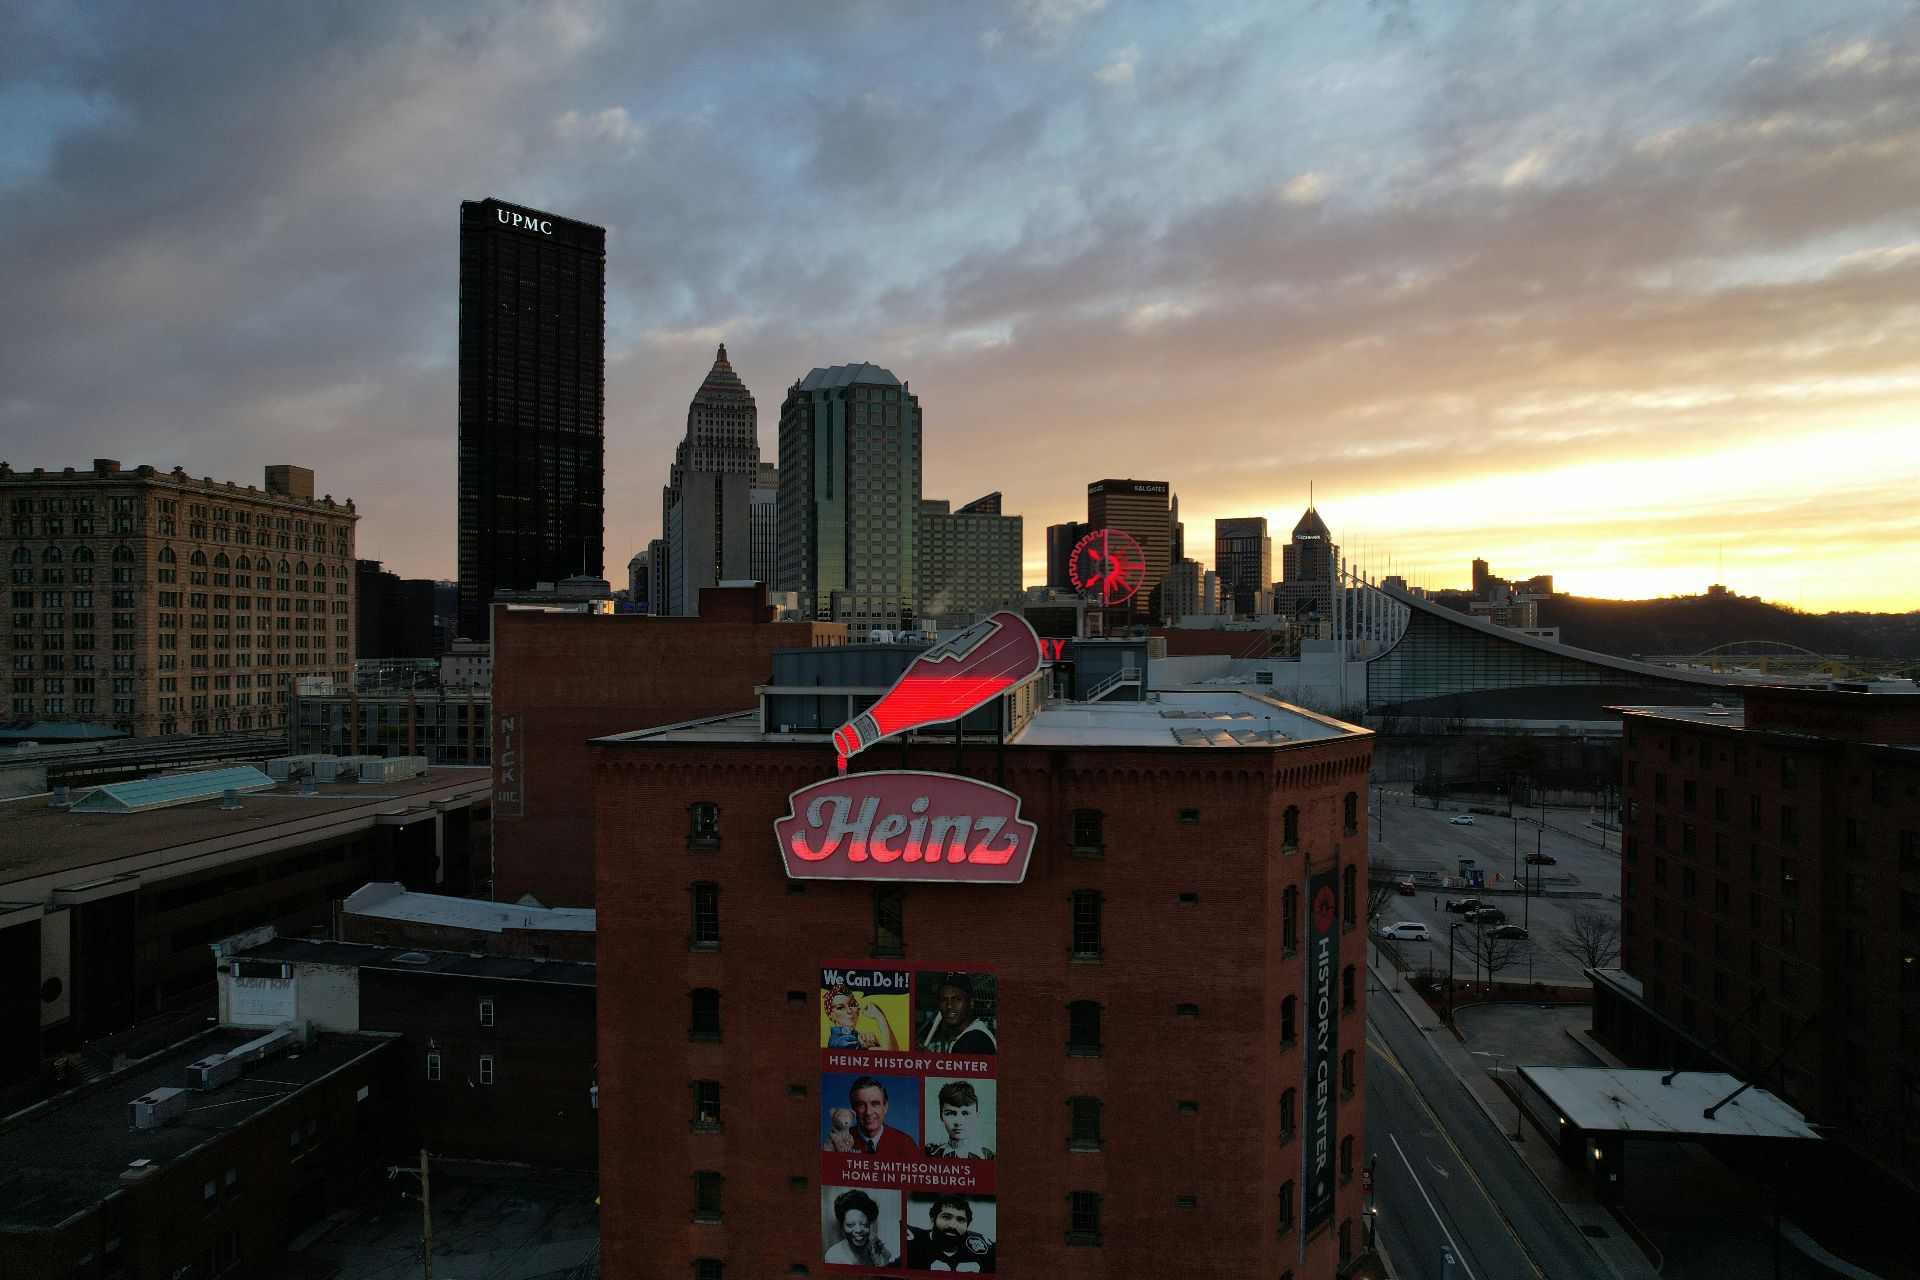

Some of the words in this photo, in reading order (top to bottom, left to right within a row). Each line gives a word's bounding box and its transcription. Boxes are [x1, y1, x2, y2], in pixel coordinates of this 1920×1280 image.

[496, 208, 552, 235] UPMC
[501, 716, 515, 784] NICK
[791, 795, 1020, 865] Heinz
[823, 969, 845, 986] We
[845, 970, 871, 987] Can
[873, 972, 892, 988] Do
[894, 972, 910, 988] It!
[1317, 936, 1330, 1053] HISTORY
[829, 1055, 870, 1067] HEINZ
[874, 1057, 932, 1070] HISTORY
[935, 1059, 988, 1072] CENTER
[1315, 1059, 1328, 1176] CENTER
[842, 1170, 878, 1182] HOME
[882, 1173, 896, 1183] IN
[900, 1174, 976, 1187] PITTSBURGH
[846, 1159, 870, 1170] THE
[873, 1161, 971, 1175] SMITHSONIAN'S
